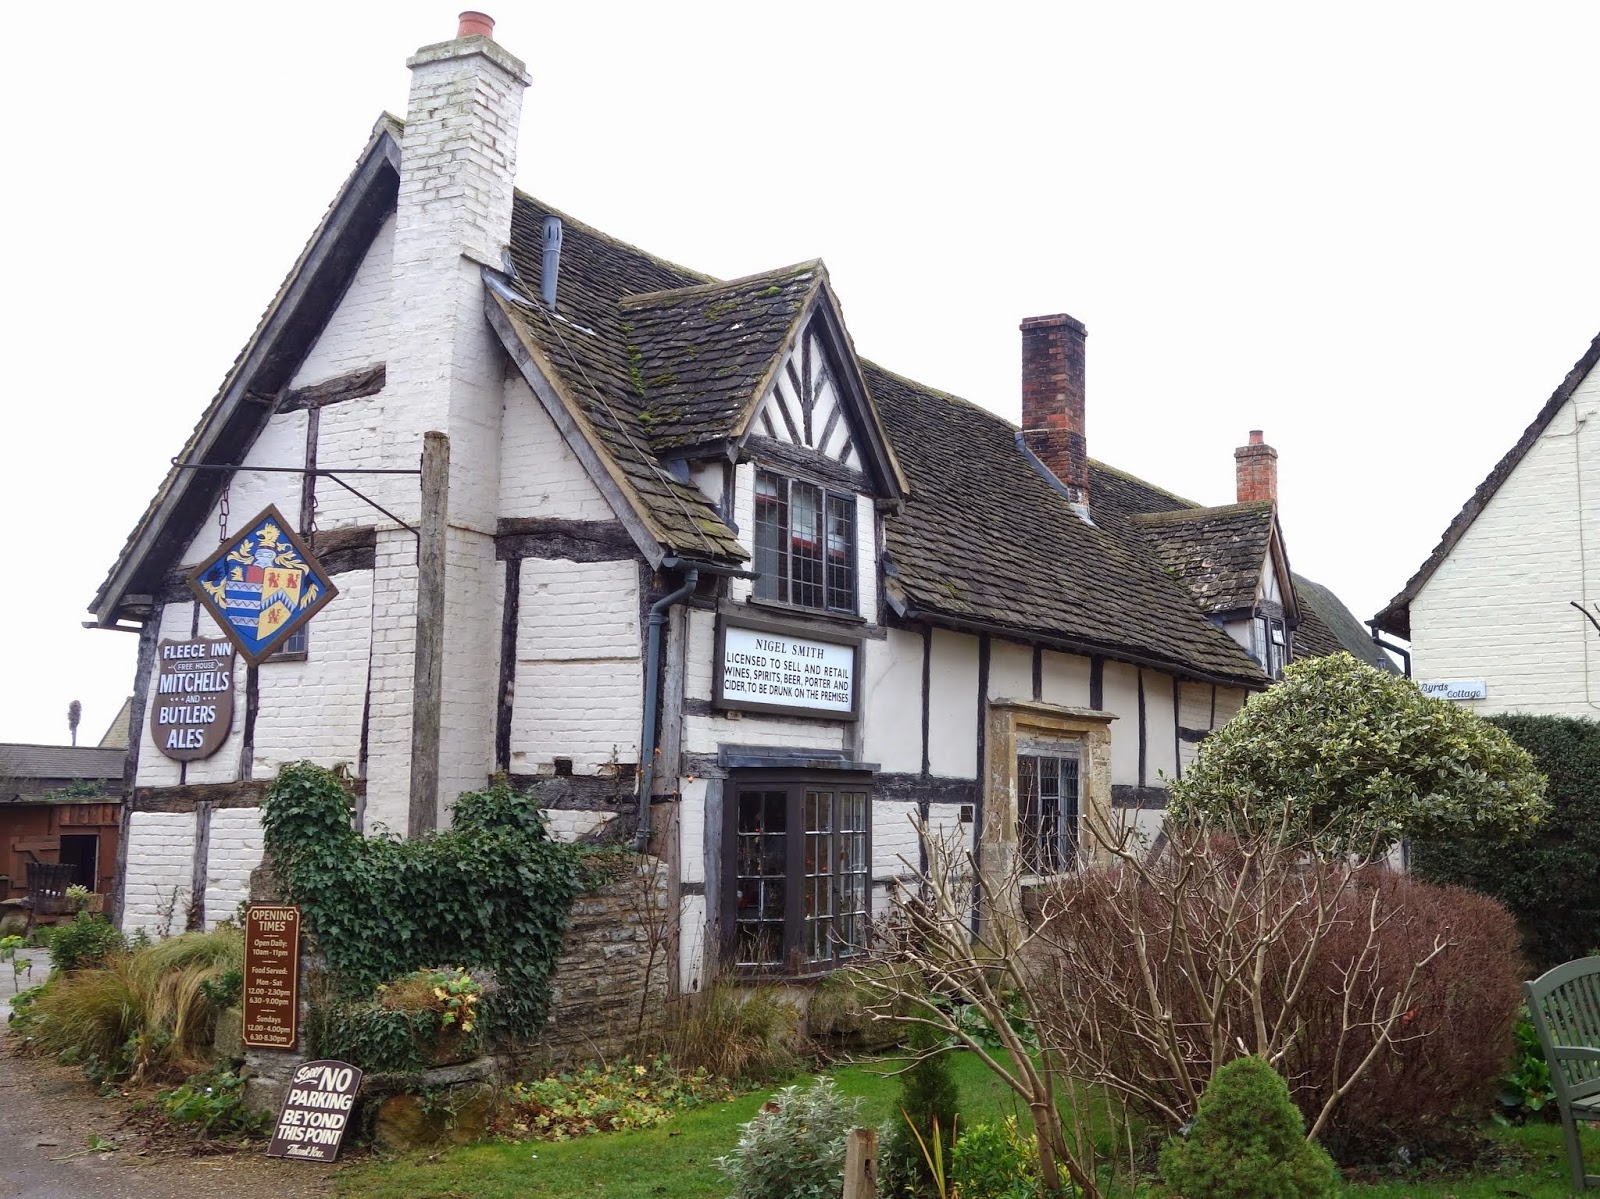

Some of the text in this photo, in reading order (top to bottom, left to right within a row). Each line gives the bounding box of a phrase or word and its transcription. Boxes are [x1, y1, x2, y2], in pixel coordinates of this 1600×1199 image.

[163, 643, 232, 659] FLEECE INN
[755, 639, 824, 659] NIGEL SMITH
[195, 661, 215, 669] HOUSE
[726, 652, 849, 679] LICENSED TO SELL AND RETAIL
[160, 672, 229, 693] MITCHELLS
[725, 665, 752, 680] WINES,
[753, 669, 782, 684] SPIRITS,
[804, 676, 831, 689] PORTER
[833, 681, 849, 691] AND
[185, 695, 200, 703] AND
[747, 682, 757, 693] TO
[759, 683, 767, 694] BE
[769, 685, 792, 698] DRUNK
[794, 688, 804, 698] ON
[806, 689, 819, 700] THE
[820, 690, 849, 703] PREMISES
[1447, 690, 1481, 699] Cottage
[159, 705, 216, 724] BUTLERS
[166, 728, 204, 748] ALES
[251, 910, 294, 921] OPENING
[258, 921, 286, 932] TIMES
[254, 939, 270, 947] Open
[251, 966, 266, 974] Food
[255, 978, 269, 986] Mon
[272, 979, 283, 987] Sat
[256, 1015, 282, 1024] Sundays
[317, 1067, 353, 1092] NO
[288, 1089, 353, 1110] PARKING
[281, 1109, 345, 1129] BEYOND
[277, 1125, 341, 1145] THIS POINT
[286, 1144, 310, 1156] Thank
